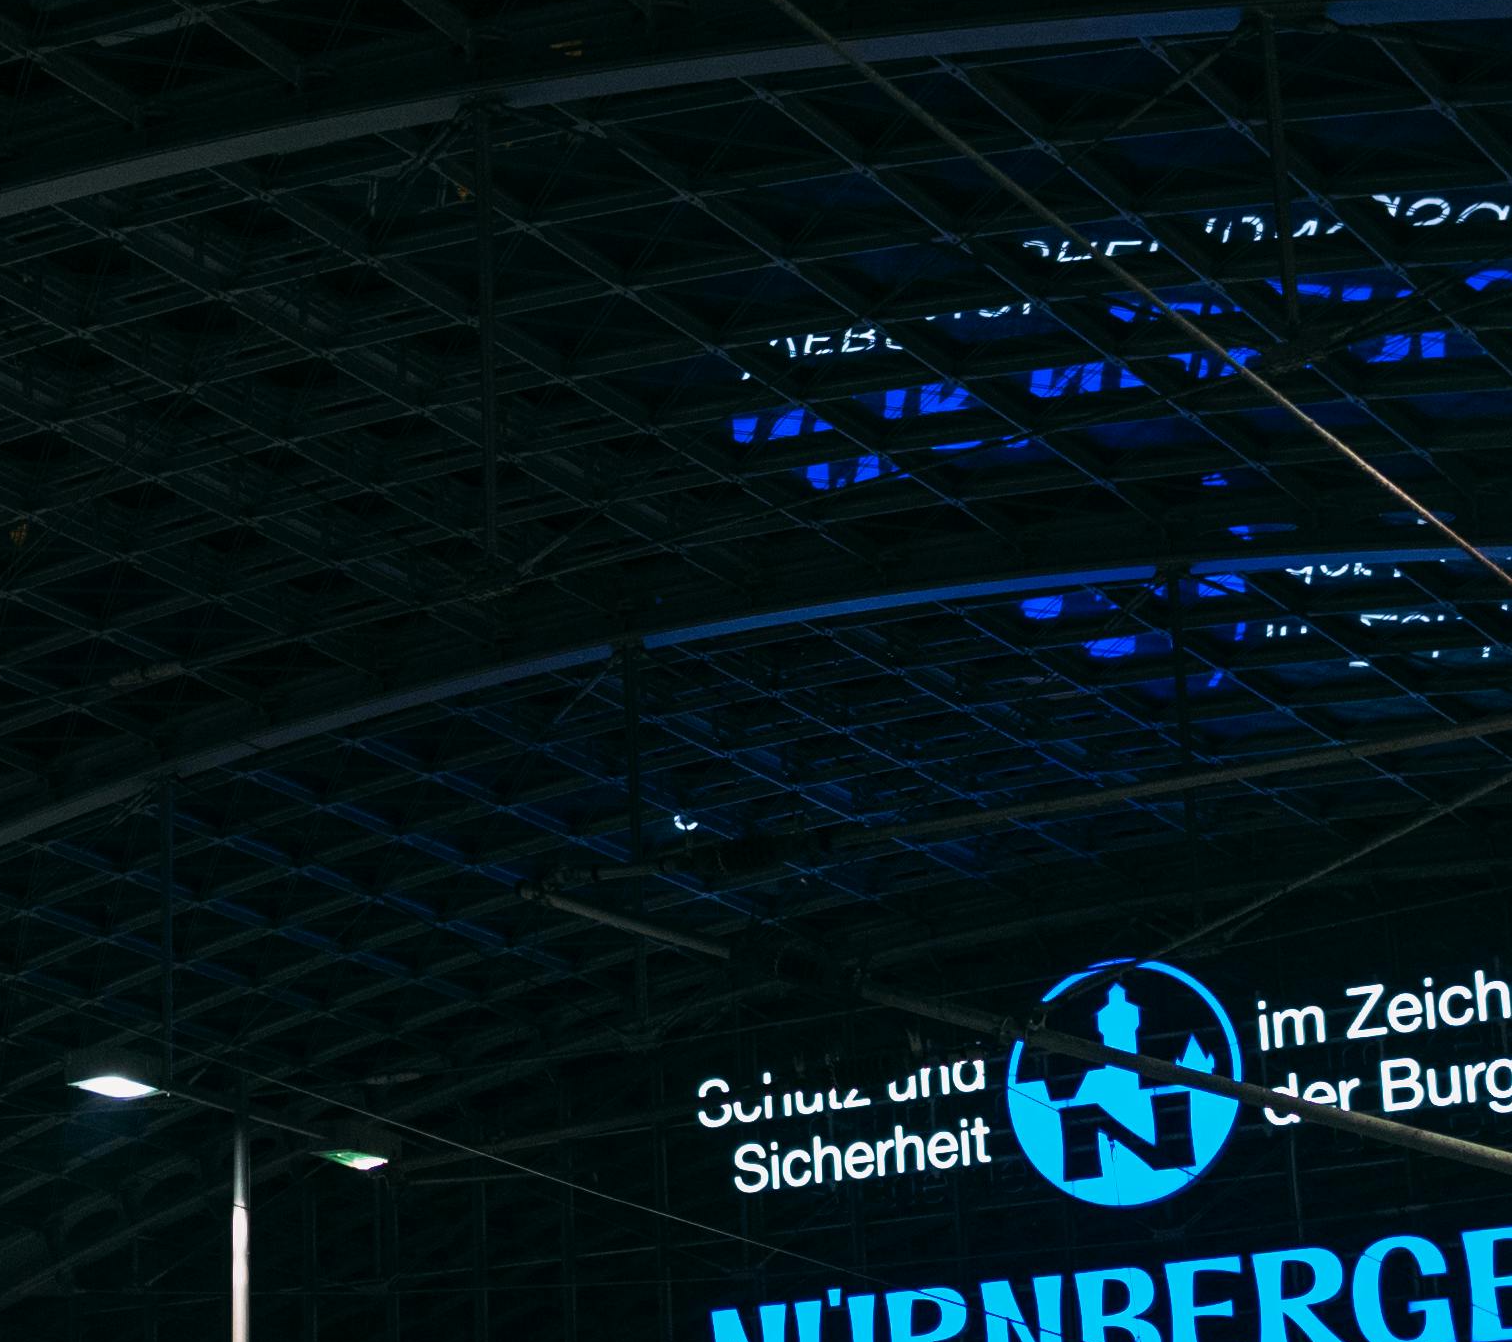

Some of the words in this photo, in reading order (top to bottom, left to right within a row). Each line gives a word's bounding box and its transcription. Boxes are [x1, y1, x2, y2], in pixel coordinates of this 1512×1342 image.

[1256, 999, 1327, 1052] im
[1263, 1071, 1361, 1127] der
[733, 1116, 992, 1194] Sicherheit
